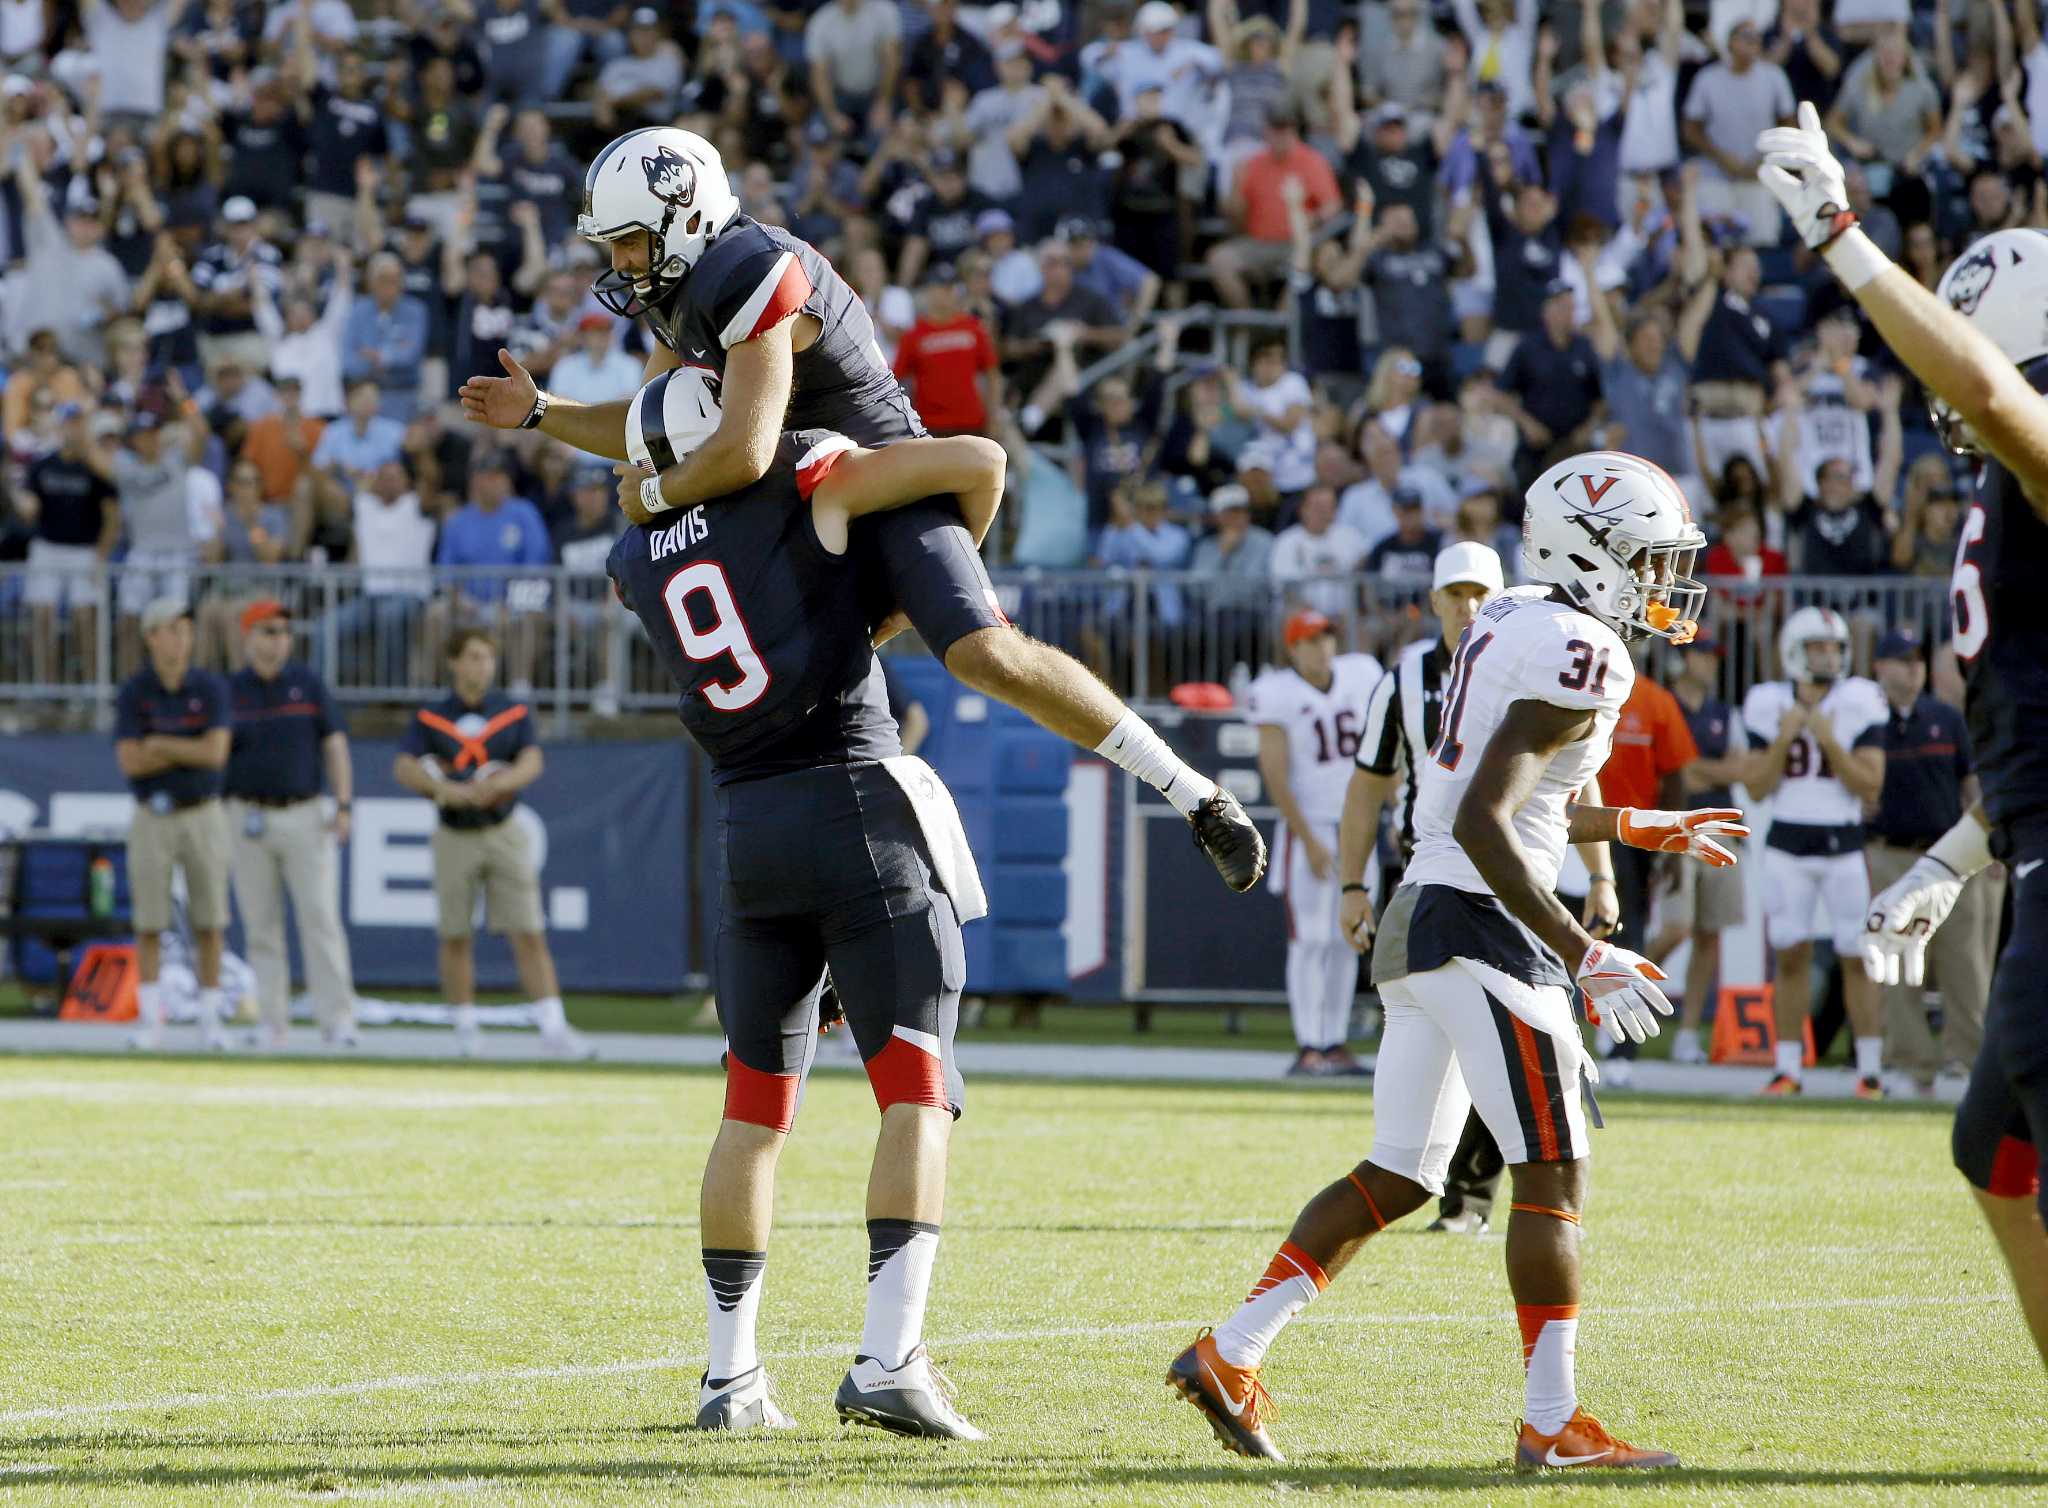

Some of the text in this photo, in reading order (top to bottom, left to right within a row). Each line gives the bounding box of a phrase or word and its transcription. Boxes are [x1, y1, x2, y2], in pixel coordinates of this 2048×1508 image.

[1578, 474, 1622, 508] V
[650, 504, 709, 561] DAVIS
[660, 559, 772, 713] 9
[1558, 638, 1611, 698] 31
[1313, 709, 1361, 763] 16
[1734, 996, 1770, 1053] 5
[865, 1379, 896, 1389] ALPHA
